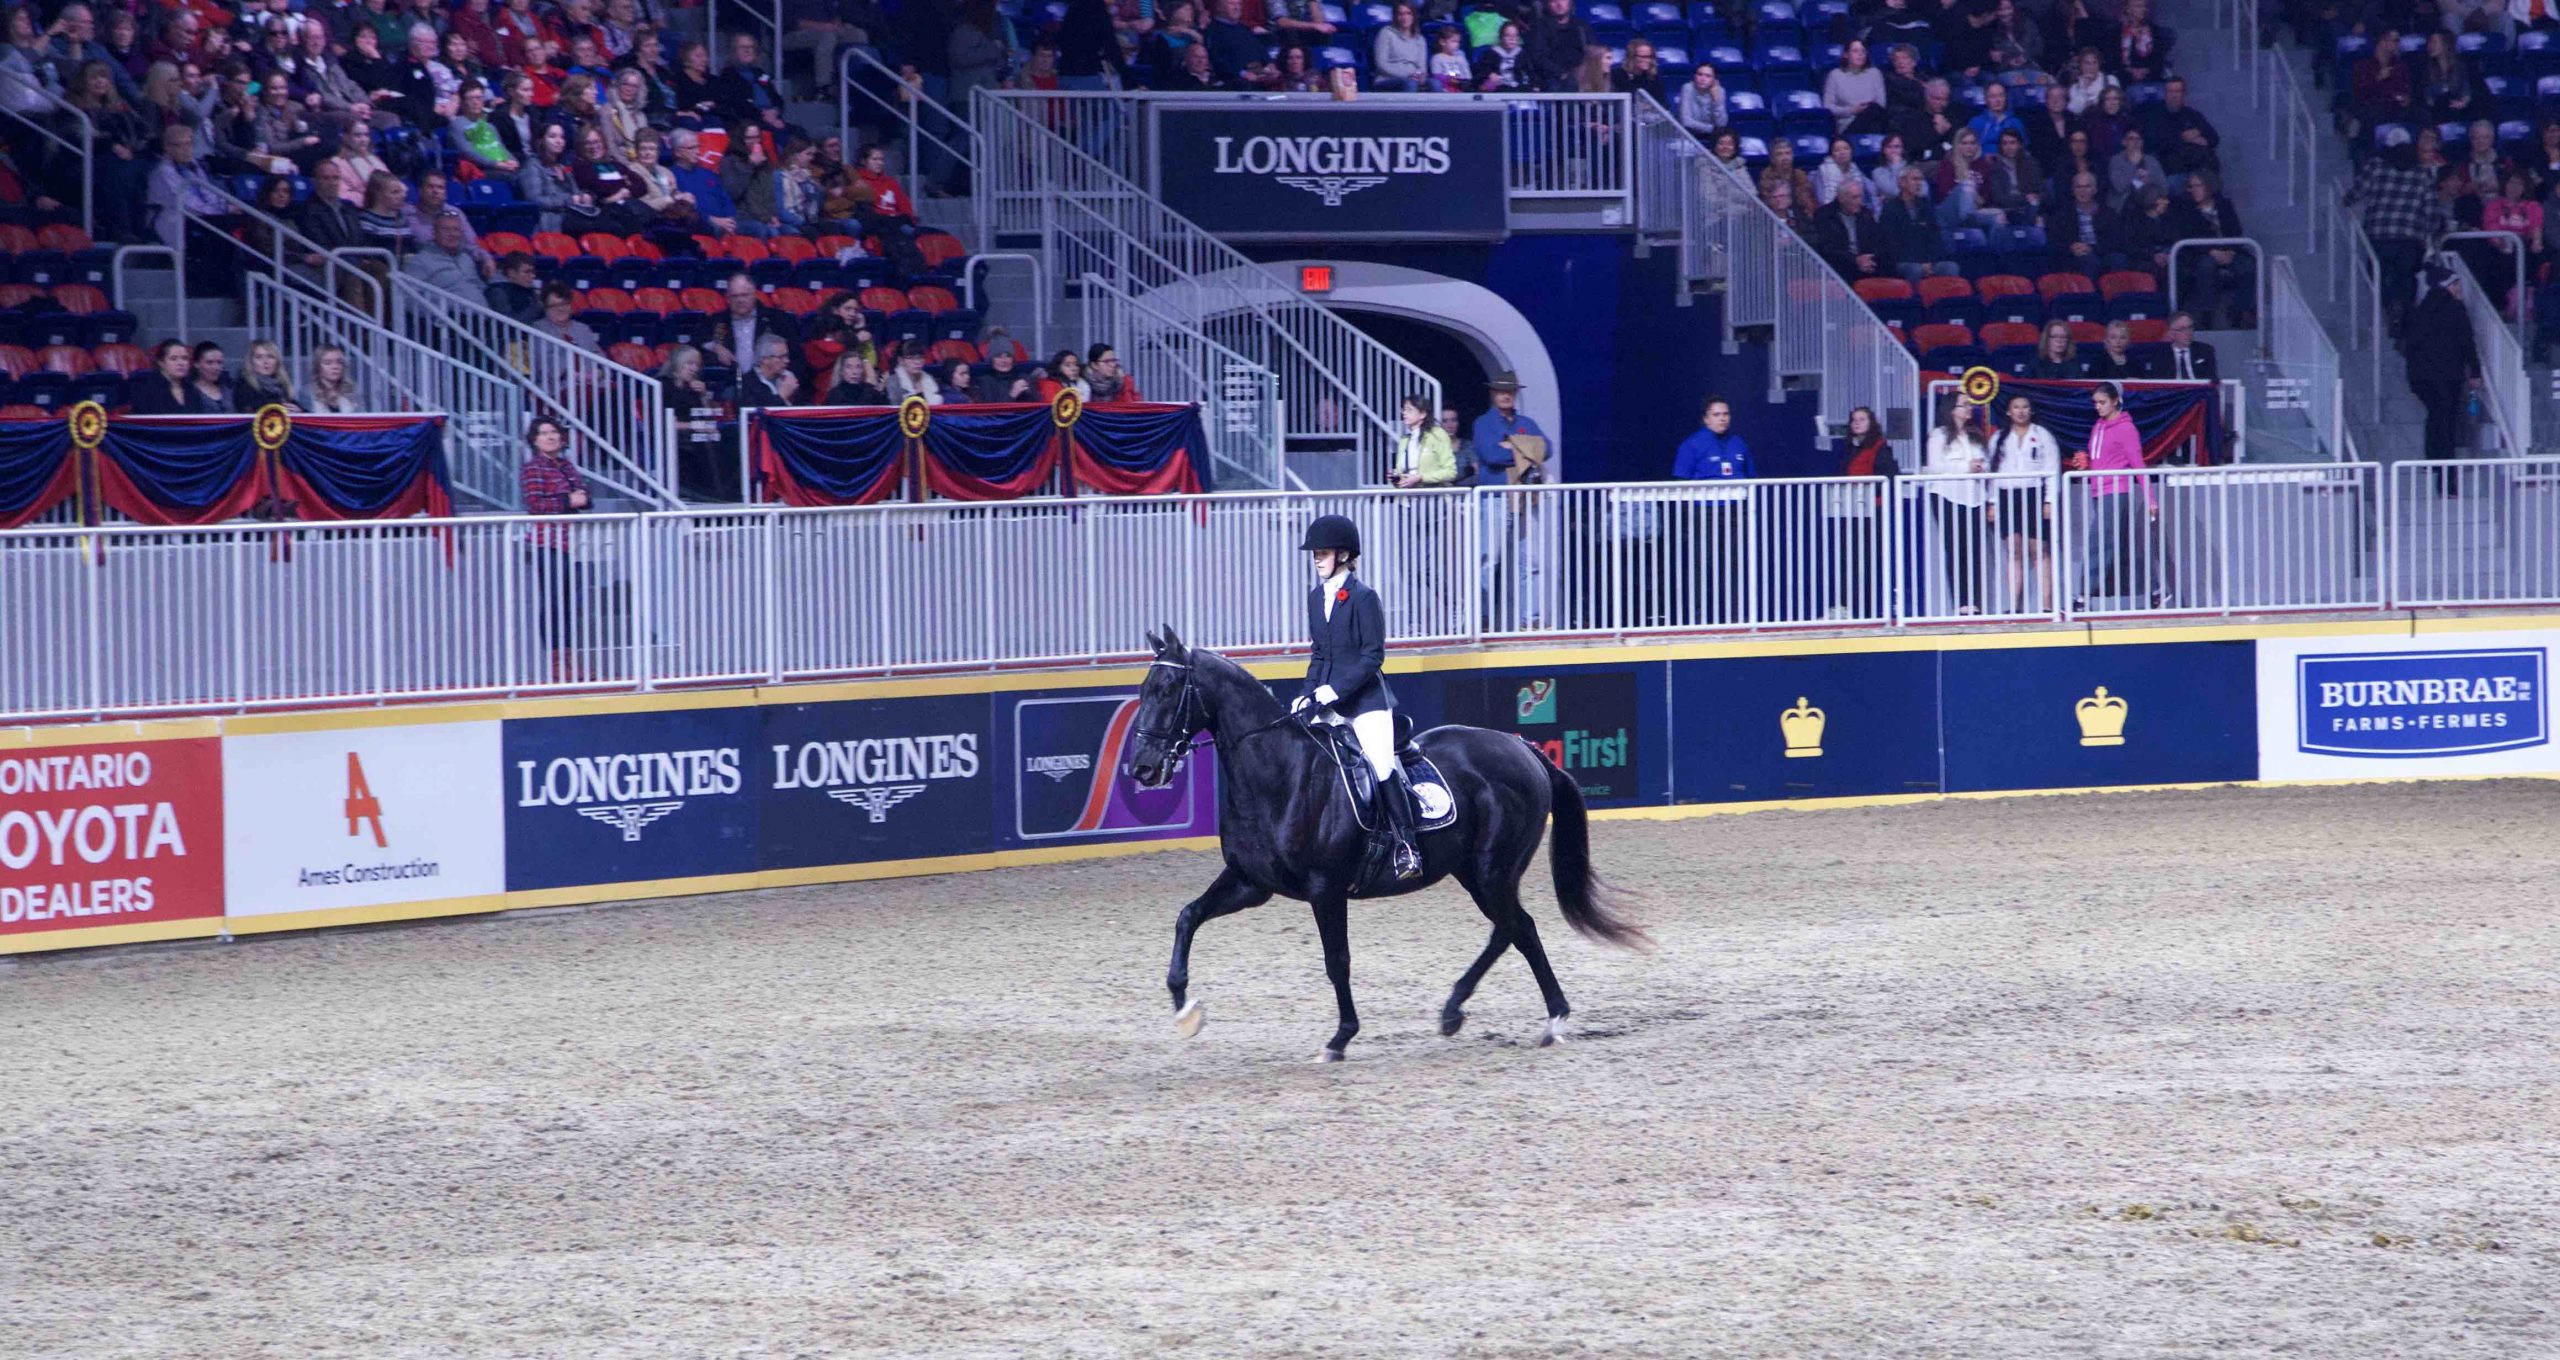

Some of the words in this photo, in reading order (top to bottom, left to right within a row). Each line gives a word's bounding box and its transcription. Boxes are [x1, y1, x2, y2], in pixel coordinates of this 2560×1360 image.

[1214, 136, 1451, 174] LONGINES
[1303, 267, 1330, 290] EXIT
[2319, 677, 2517, 707] BURNBRAE
[0, 752, 152, 795] ONTARIO
[518, 748, 742, 807] LONGINES
[772, 733, 980, 790] LONGINES
[1026, 754, 1091, 773] LONGINES
[0, 802, 188, 870] OYOTA
[298, 867, 341, 888] Ames
[343, 857, 440, 884] Construction
[0, 876, 155, 923] DEALERS
